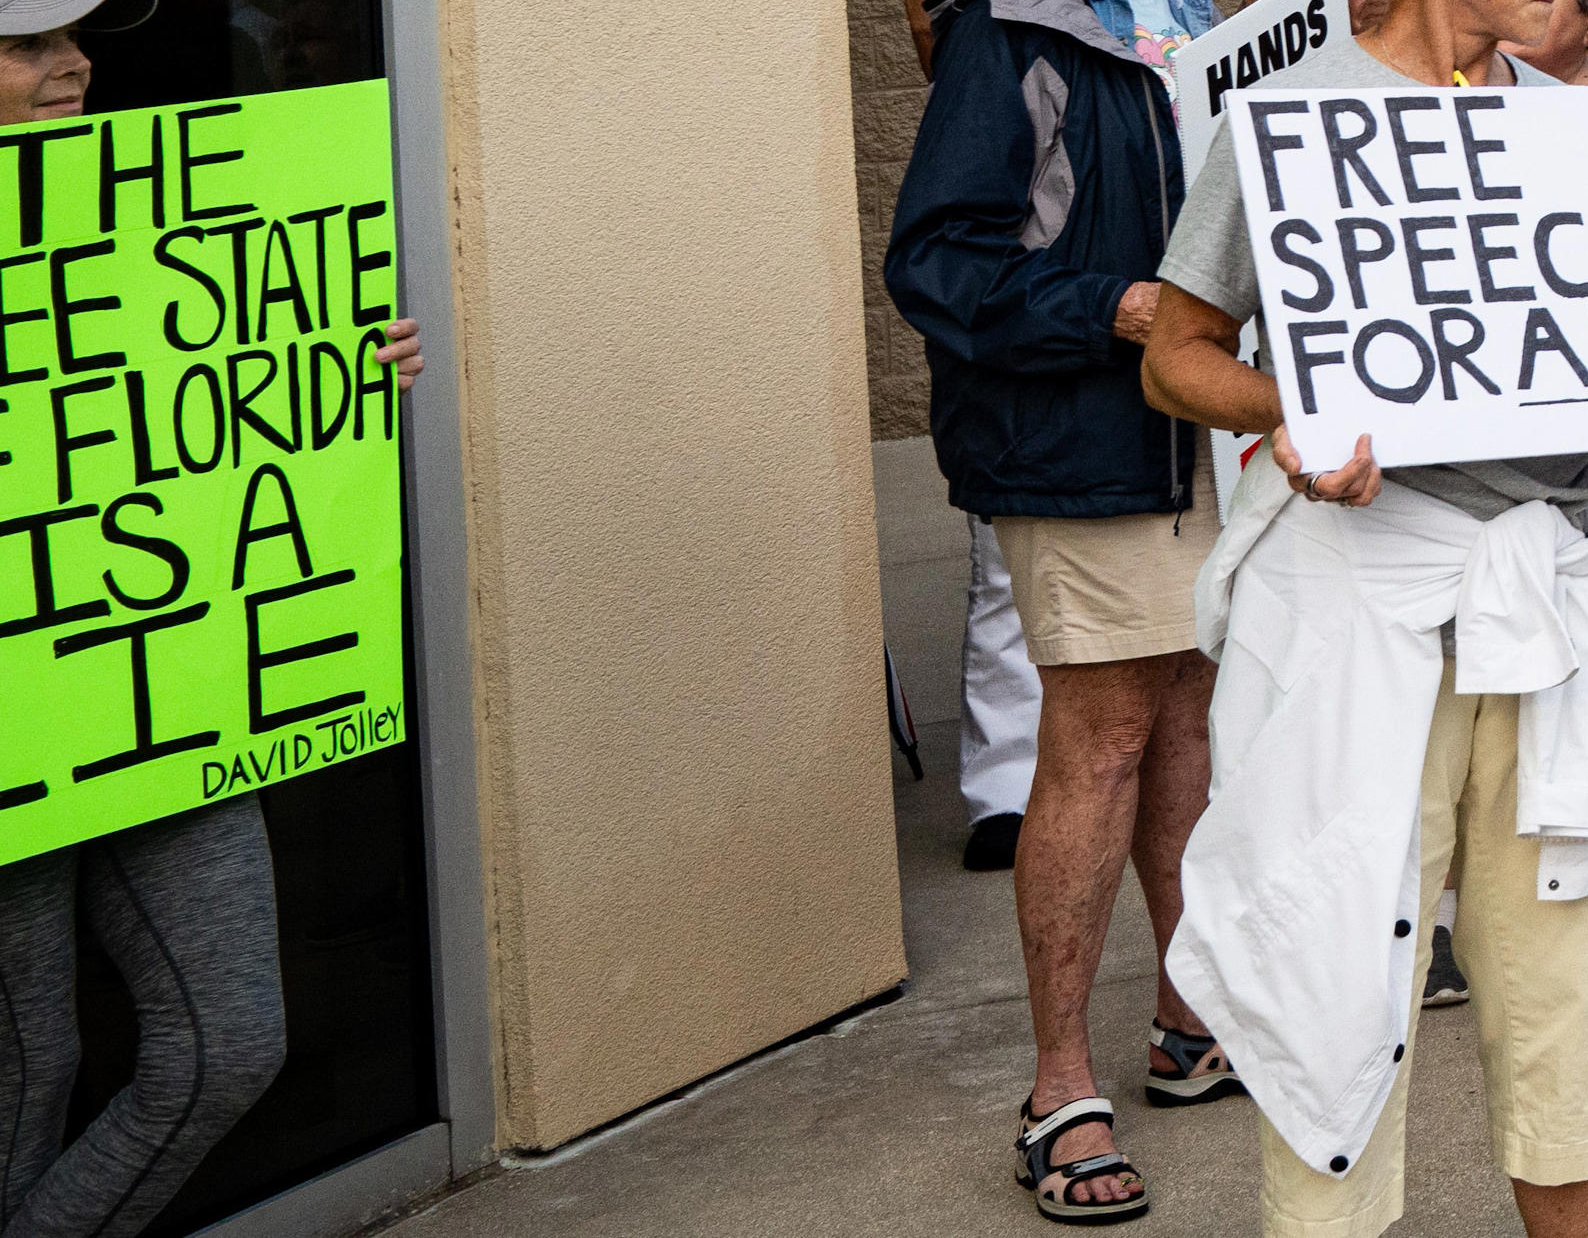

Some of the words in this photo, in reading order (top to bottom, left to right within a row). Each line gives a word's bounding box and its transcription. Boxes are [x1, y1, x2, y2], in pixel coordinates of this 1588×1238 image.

[0, 102, 258, 249] THE
[1247, 94, 1523, 212] FREE
[154, 201, 393, 353] STATE
[51, 327, 394, 505] FLORIDA
[0, 491, 191, 636] IS
[233, 462, 314, 591] A
[203, 734, 312, 799] DAVID
